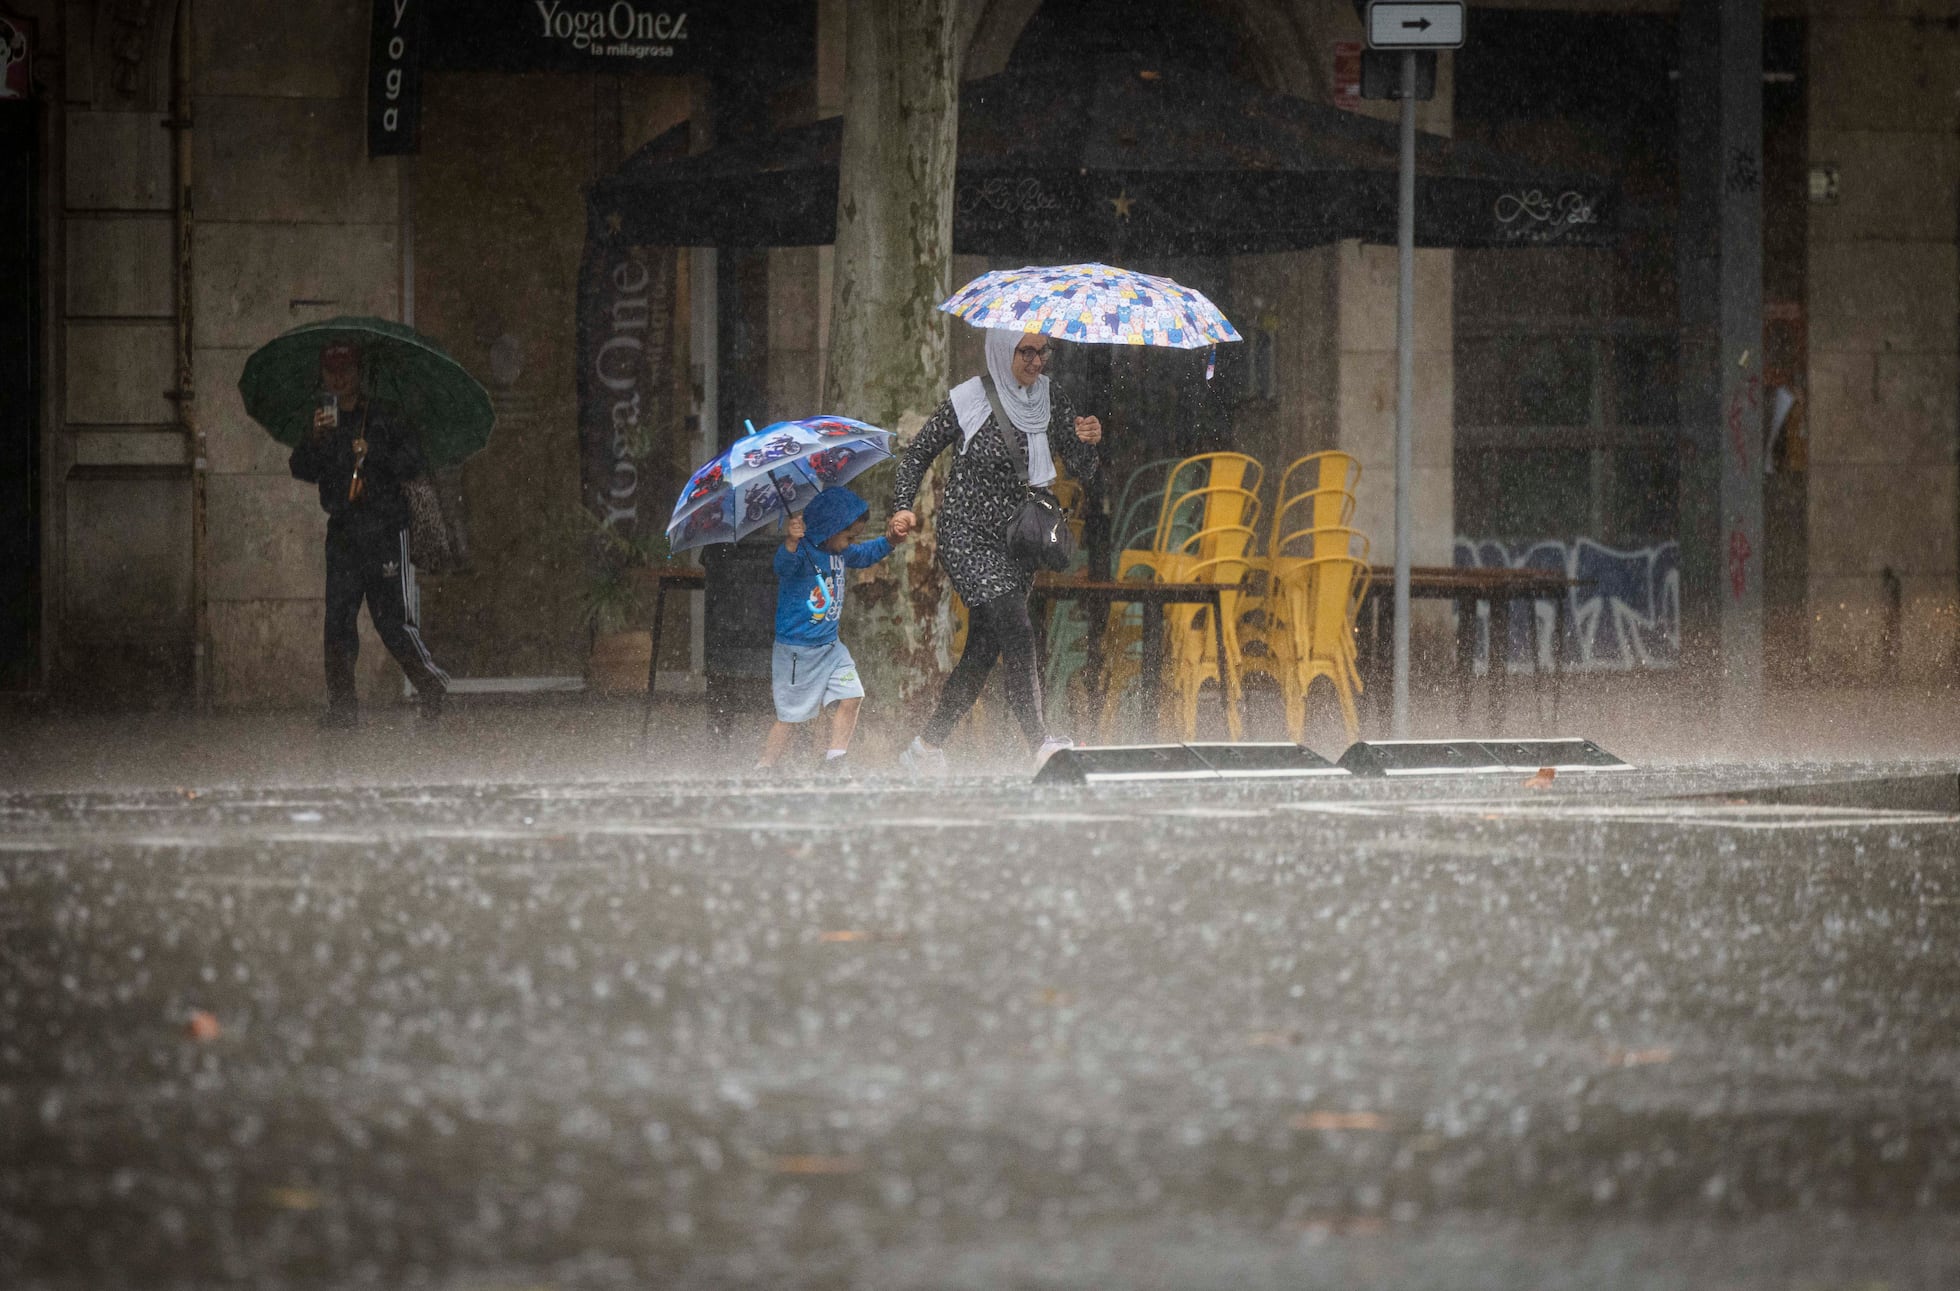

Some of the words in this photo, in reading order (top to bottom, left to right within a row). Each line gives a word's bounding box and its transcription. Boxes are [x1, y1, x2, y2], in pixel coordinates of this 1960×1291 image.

[383, 0, 408, 132] yoga
[591, 43, 604, 56] la
[606, 43, 674, 59] milagrosa
